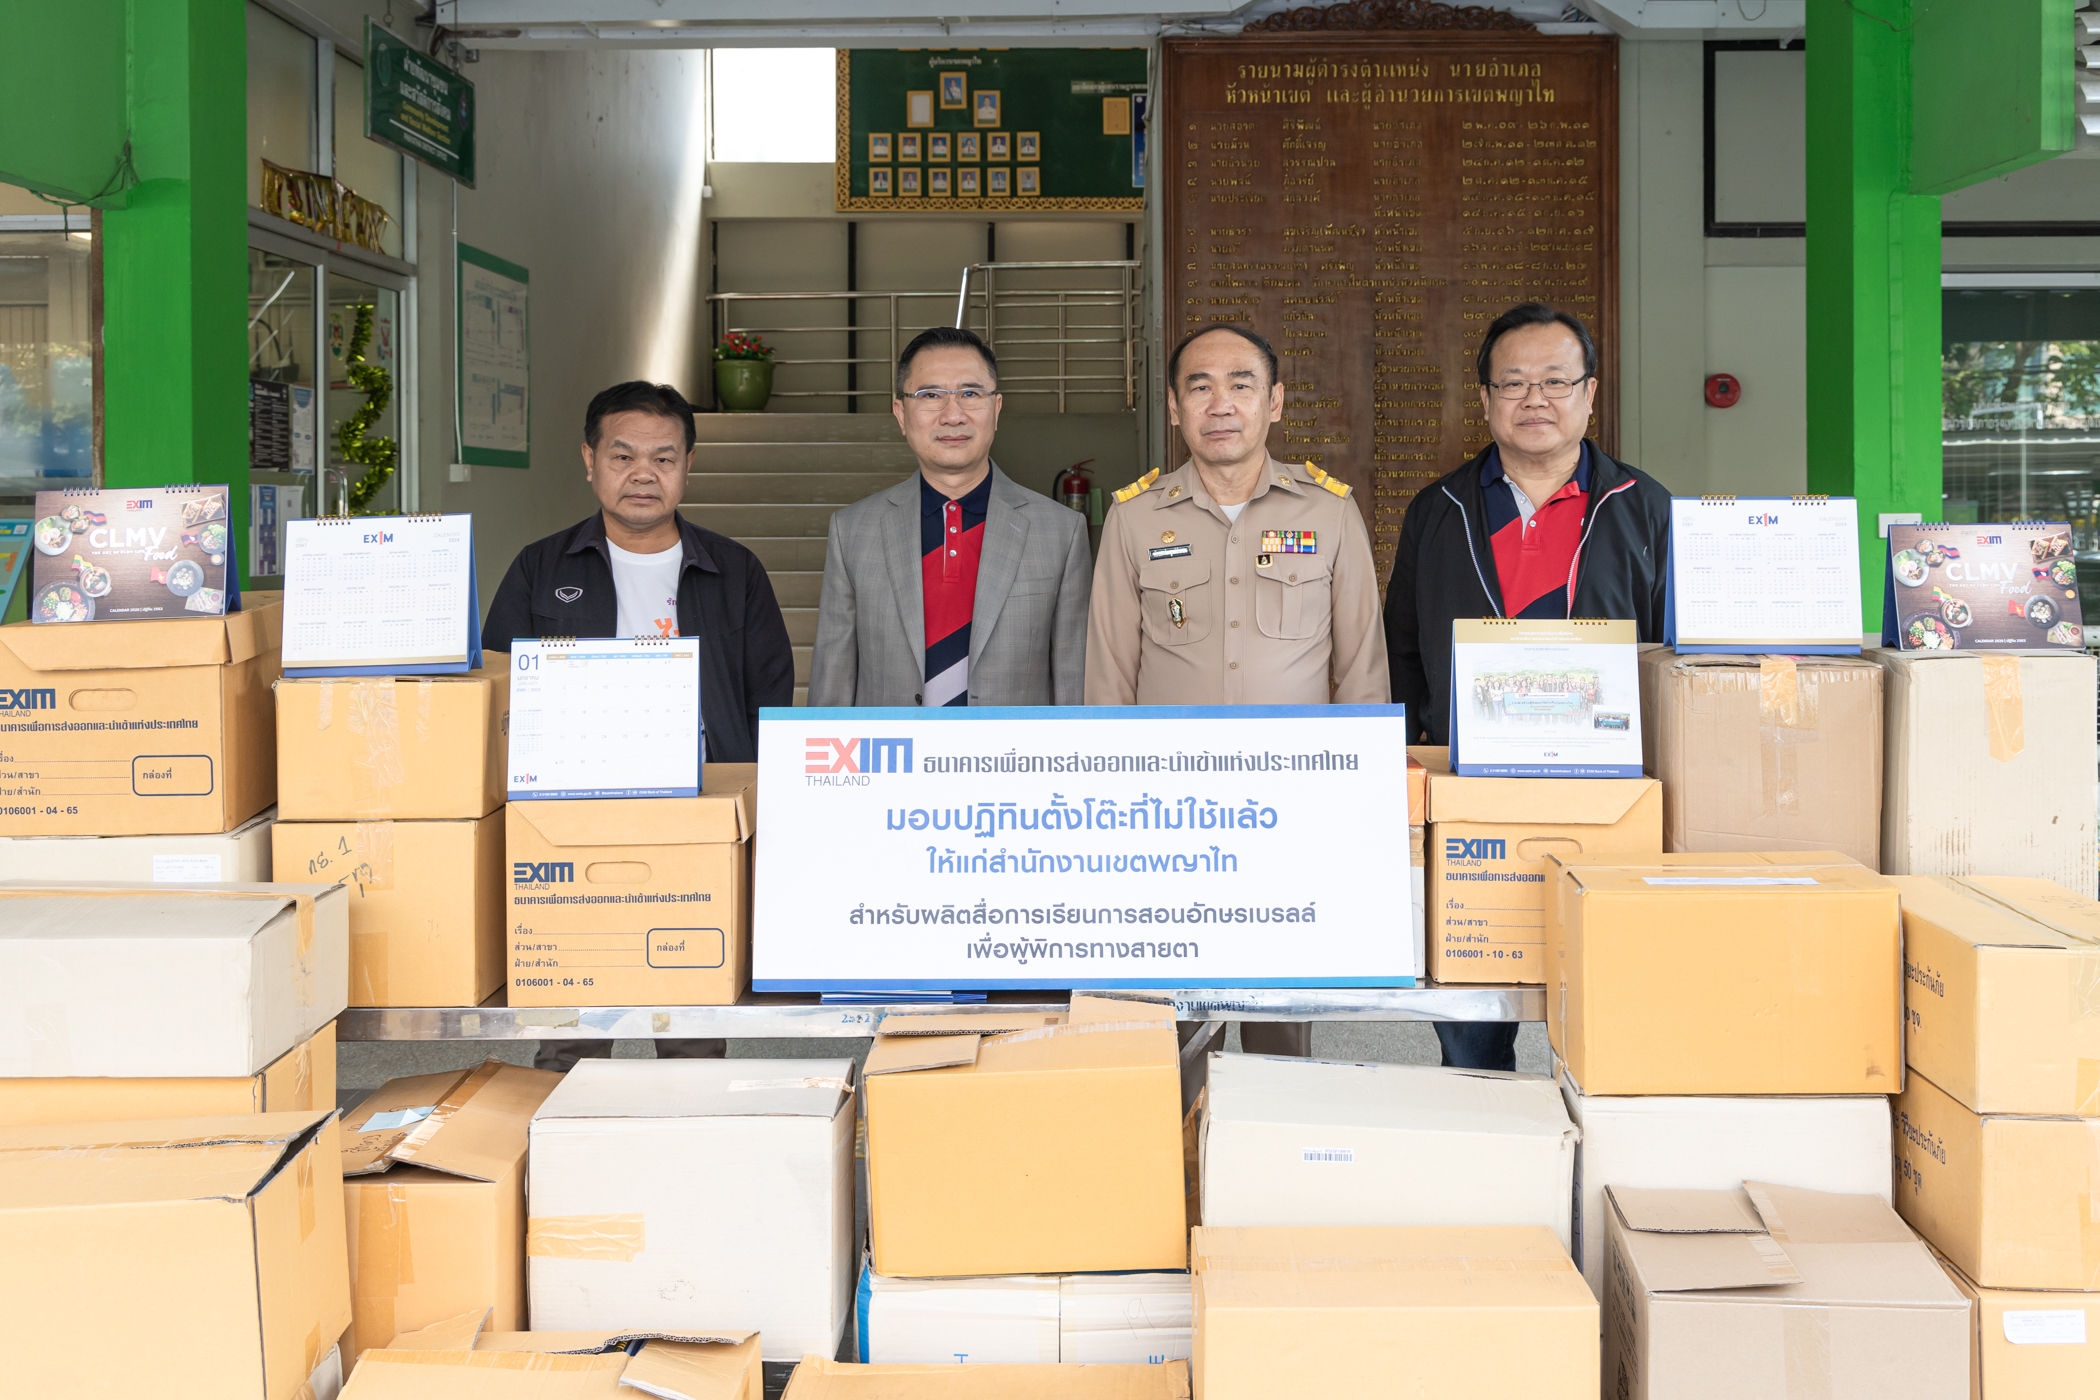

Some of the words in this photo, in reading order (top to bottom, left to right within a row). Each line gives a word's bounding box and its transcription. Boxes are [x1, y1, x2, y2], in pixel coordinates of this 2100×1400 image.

[1238, 57, 1429, 86] รายนามผู้ดำรงตำแหน่ง
[1449, 56, 1542, 79] นายอำเภอ
[1225, 82, 1311, 104] หัวหน้าเขต
[1326, 78, 1555, 111] และผู้อำนวยการเขตพญาไท
[126, 499, 153, 510] EXIM
[89, 526, 168, 552] CLMV
[1976, 535, 2003, 545] EXIM
[143, 544, 178, 566] Food
[1945, 562, 2019, 582] CLMV
[1999, 579, 2032, 595] Food
[518, 654, 540, 671] 01
[0, 688, 56, 709] EXIM
[0, 710, 32, 718] HAILAND
[0, 719, 199, 732] นาคารเพื่อการส่งออกและนำเข้าแห่งประเทศไทย
[805, 736, 914, 774] EXIM
[922, 747, 1360, 776] ธนาคารเพื่อการส่งออกและนำเข้าแห่งประเทศไทย
[143, 767, 173, 780] กล่องที่
[805, 774, 871, 788] THAILAND
[46, 806, 58, 815] 04
[66, 806, 79, 814] 65
[886, 791, 1279, 838] มอบปฏิทินตั้งโต๊ะที่ไม่ใช้แล้ว
[1446, 838, 1506, 860] EXIM
[926, 845, 1239, 876] ให้แก่สำนักงานเขตพญาไท
[1446, 859, 1482, 867] THAILAND
[513, 862, 574, 883] EXIM
[1446, 870, 1546, 883] ธนาคารเพื่อการส่งออกแ
[514, 883, 550, 891] THAILAND
[514, 892, 712, 906] ธนาคารเพื่อการส่งออกและนำเข้าแห่งประเทศไทย
[1446, 897, 1465, 909] เรื่อง
[849, 897, 1317, 927] สำหรับผลิตสื่อการเรียนการสอนอักษรเบรลล์
[1446, 916, 1488, 927] ส่วน/สาขา
[514, 923, 533, 936] เรื่อง
[514, 942, 558, 952] ส่วน/สาขา
[656, 940, 685, 952] กล่องที่
[966, 936, 1200, 966] เพื่อผู้พิการทางสายตา
[1446, 949, 1483, 959] 0106001
[1492, 950, 1504, 959] 10
[1511, 950, 1523, 960] 63
[515, 978, 554, 987] 0106001
[563, 978, 575, 986] 04
[582, 977, 595, 986] 65
